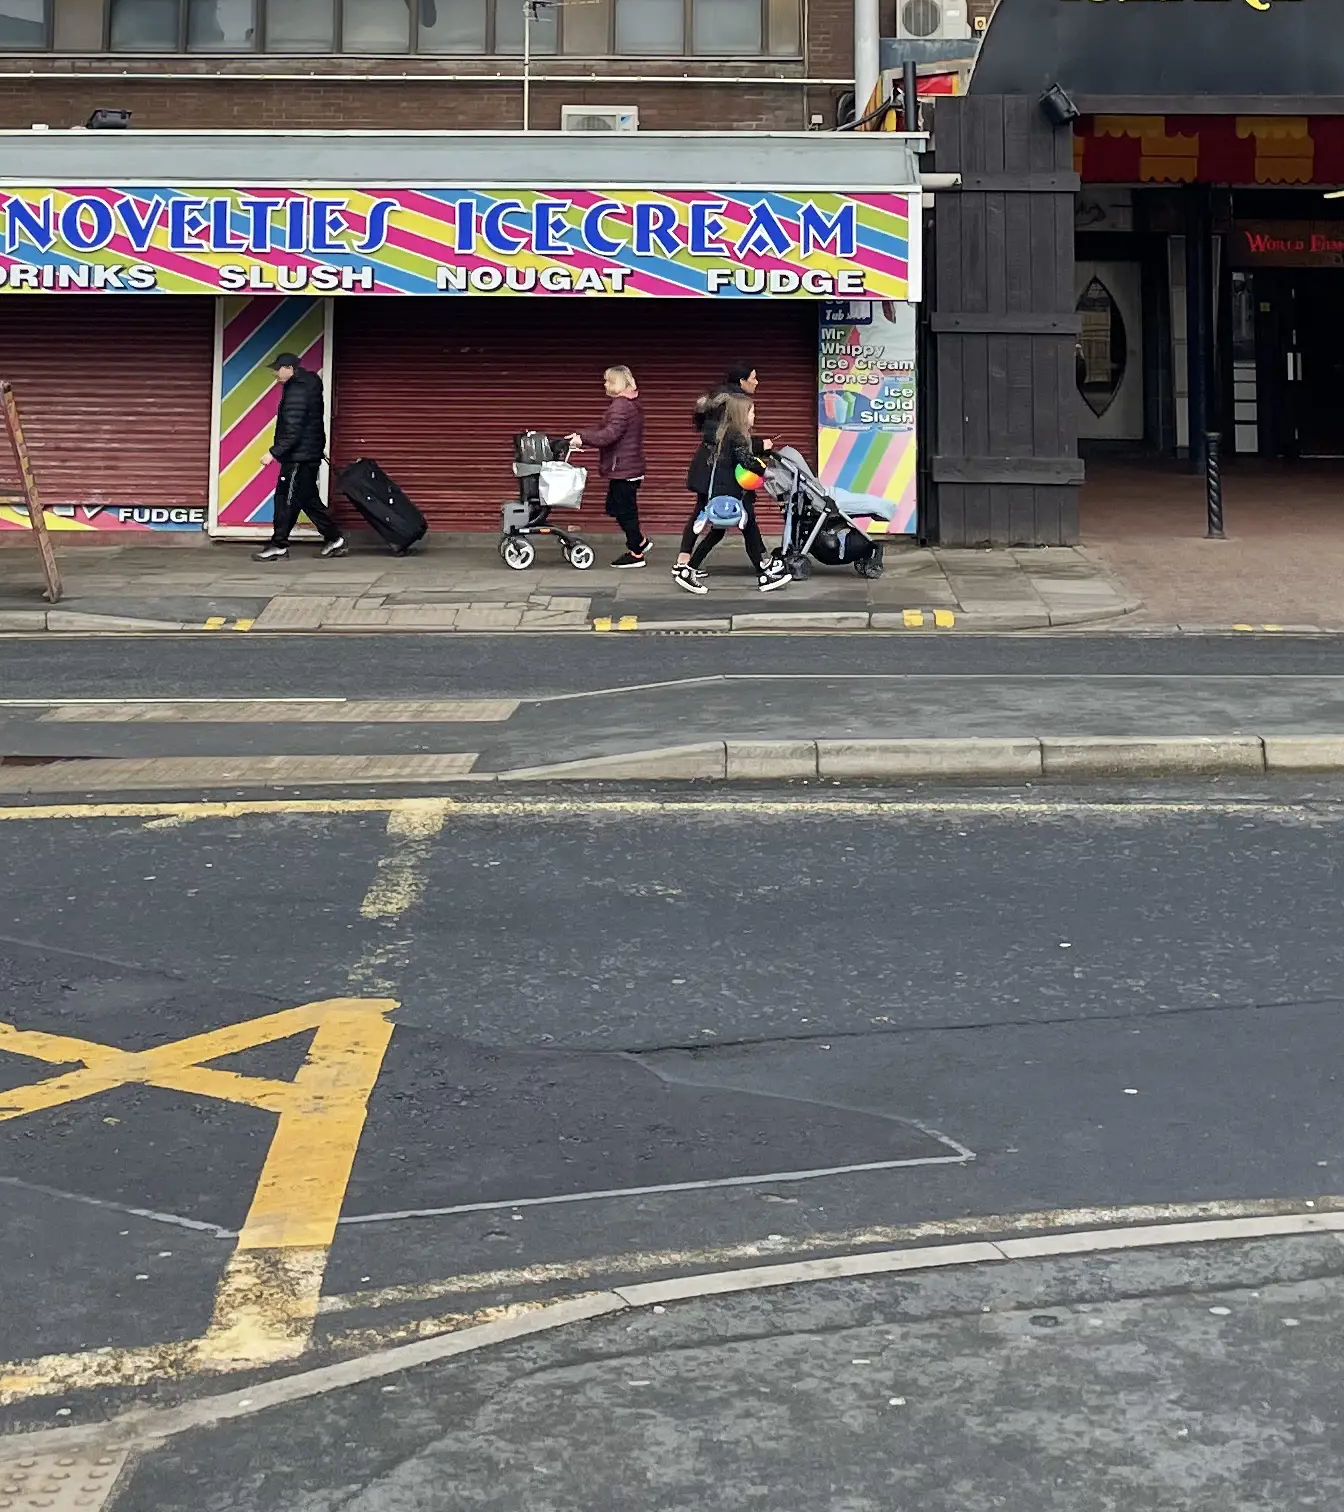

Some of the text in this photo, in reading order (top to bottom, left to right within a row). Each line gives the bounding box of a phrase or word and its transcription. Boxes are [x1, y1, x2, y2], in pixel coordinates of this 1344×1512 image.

[4, 194, 404, 255] NOVELTIES
[218, 265, 375, 291] SLUSH
[436, 266, 634, 293] NOUGAT
[707, 268, 867, 294] FUDGE
[825, 309, 844, 321] Tub
[821, 328, 845, 340] Mr
[821, 343, 885, 358] Whippy
[821, 357, 915, 371] Ice Cream
[820, 371, 880, 385] Cones
[884, 386, 915, 397] Ice
[869, 398, 915, 411] Cold
[859, 411, 915, 424] Slush
[118, 508, 205, 524] FUDGE
